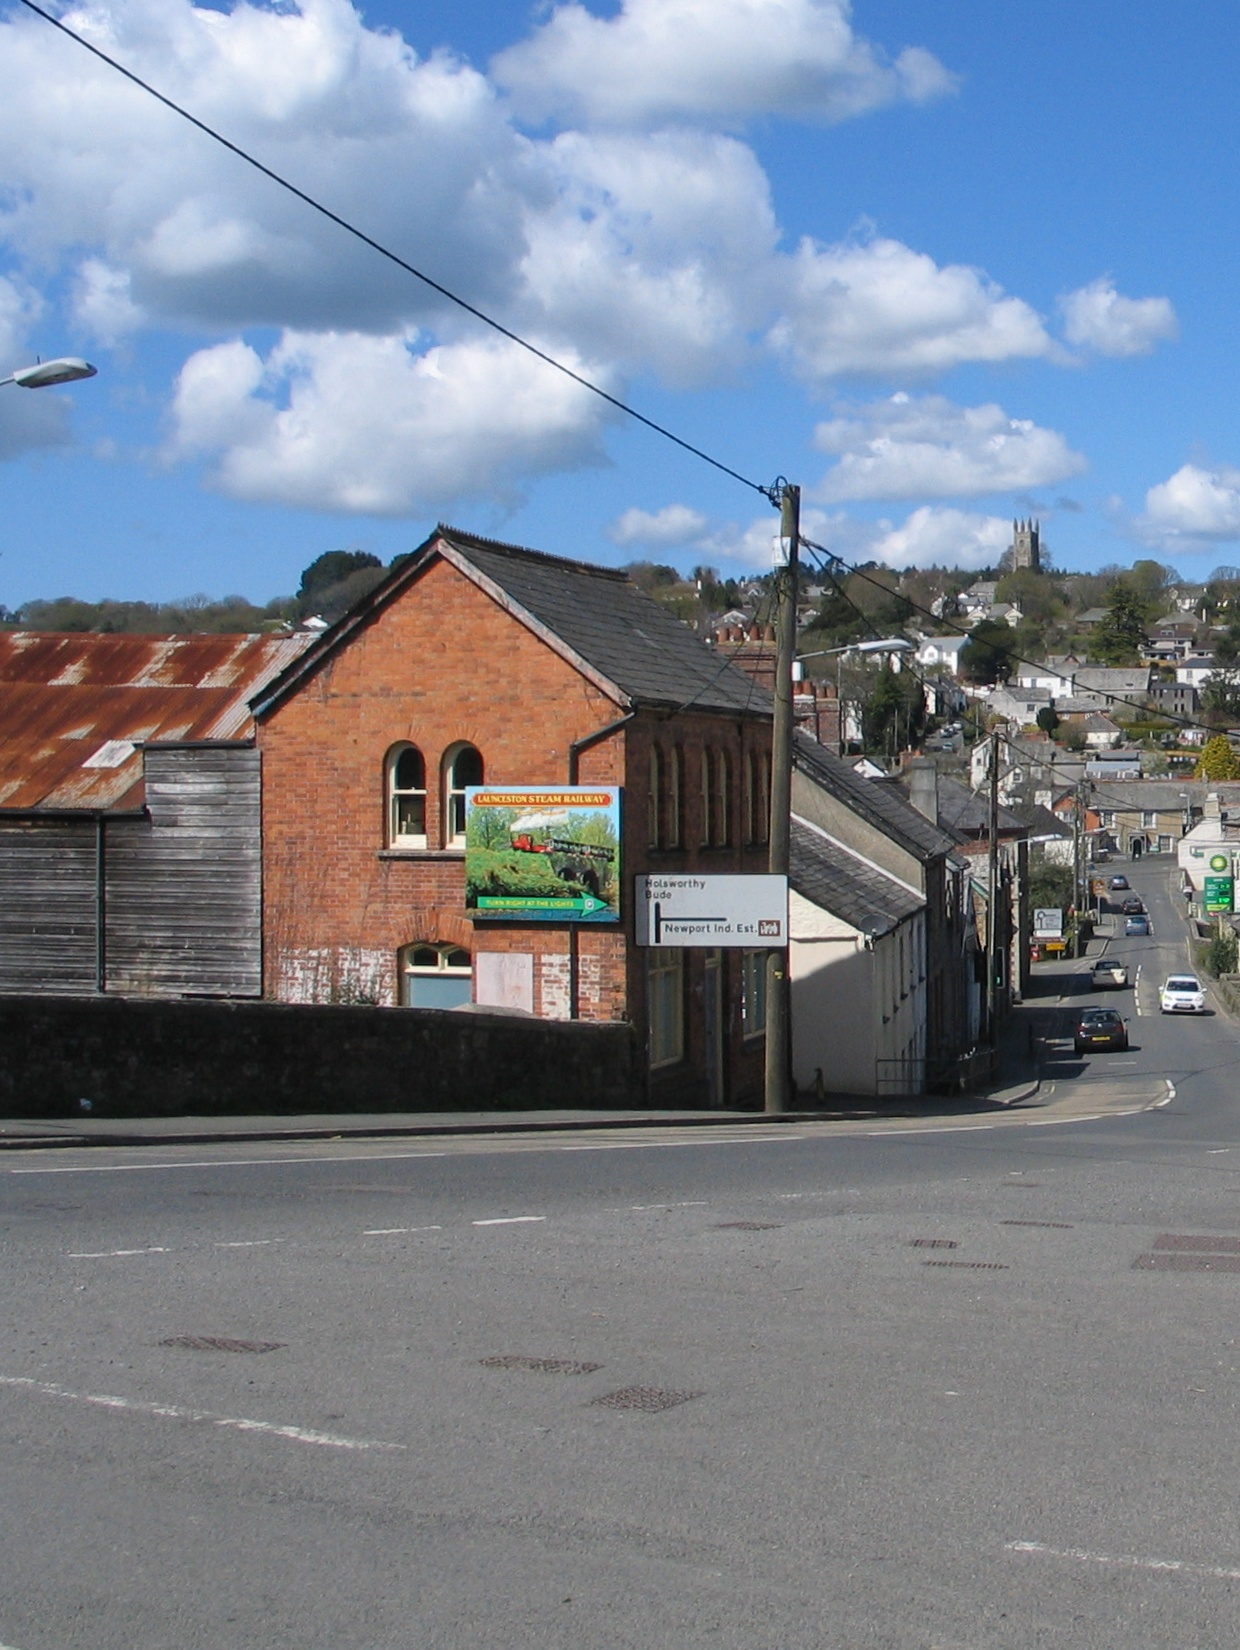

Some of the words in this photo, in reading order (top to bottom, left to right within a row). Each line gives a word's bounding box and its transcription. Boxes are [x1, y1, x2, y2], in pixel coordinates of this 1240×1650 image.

[477, 795, 527, 804] LAUNCESTON
[528, 795, 562, 803] STEAM
[563, 795, 605, 803] RAILWAY
[645, 879, 706, 889] Holsworthy
[645, 890, 672, 900] Bude
[665, 923, 711, 935] Newport
[714, 923, 734, 933] Ind.
[737, 923, 758, 933] Est.
